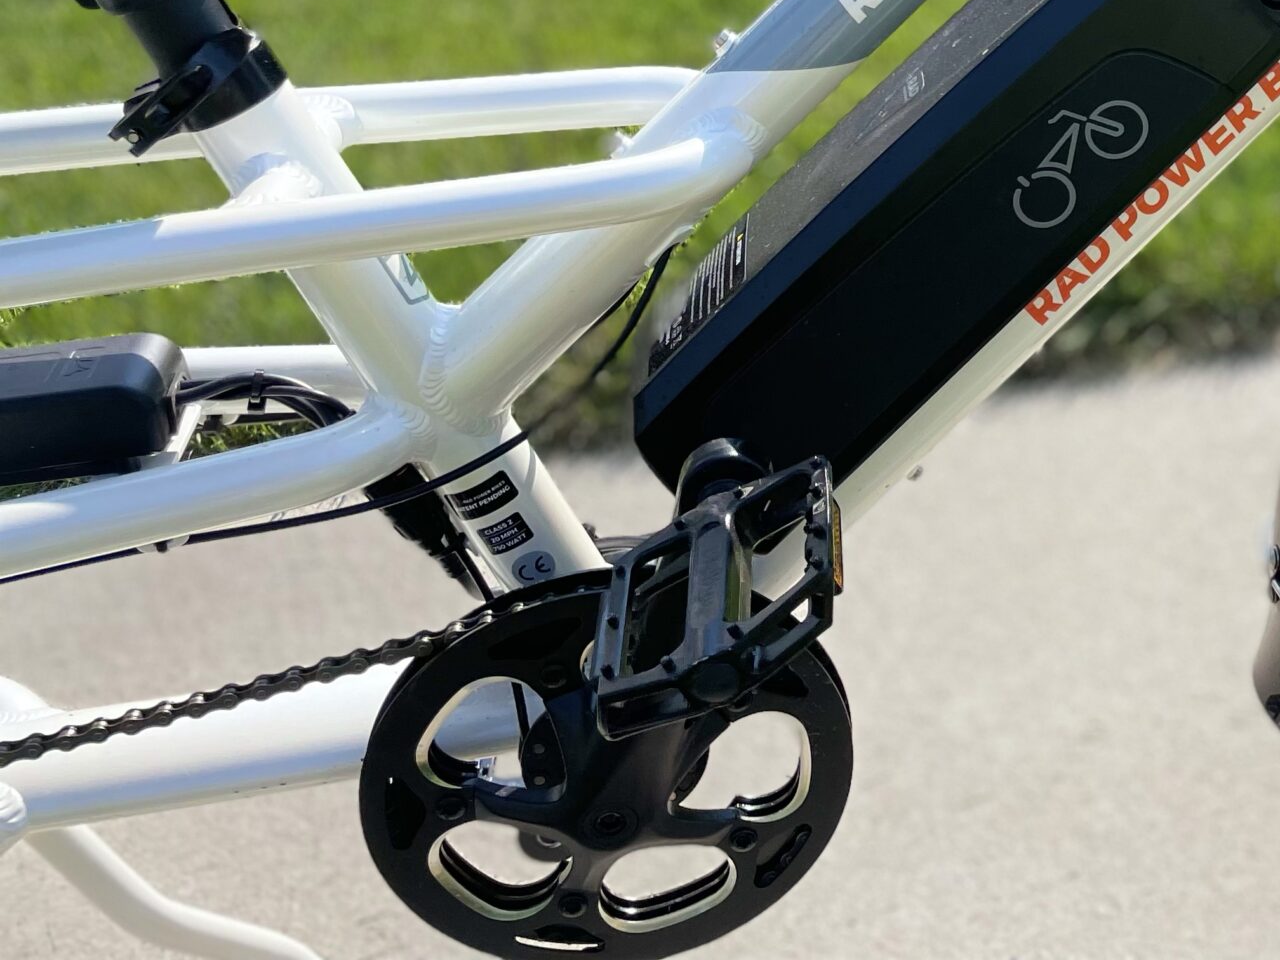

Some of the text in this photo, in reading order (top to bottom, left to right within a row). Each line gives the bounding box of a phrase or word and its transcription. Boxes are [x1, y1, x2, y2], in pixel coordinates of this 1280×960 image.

[1024, 235, 1111, 326] RAD
[1111, 94, 1262, 241] POWER
[479, 485, 511, 507] PENDING
[484, 523, 508, 536] CLASS
[490, 527, 518, 544] 20 MPH
[494, 533, 527, 552] 750 WATT
